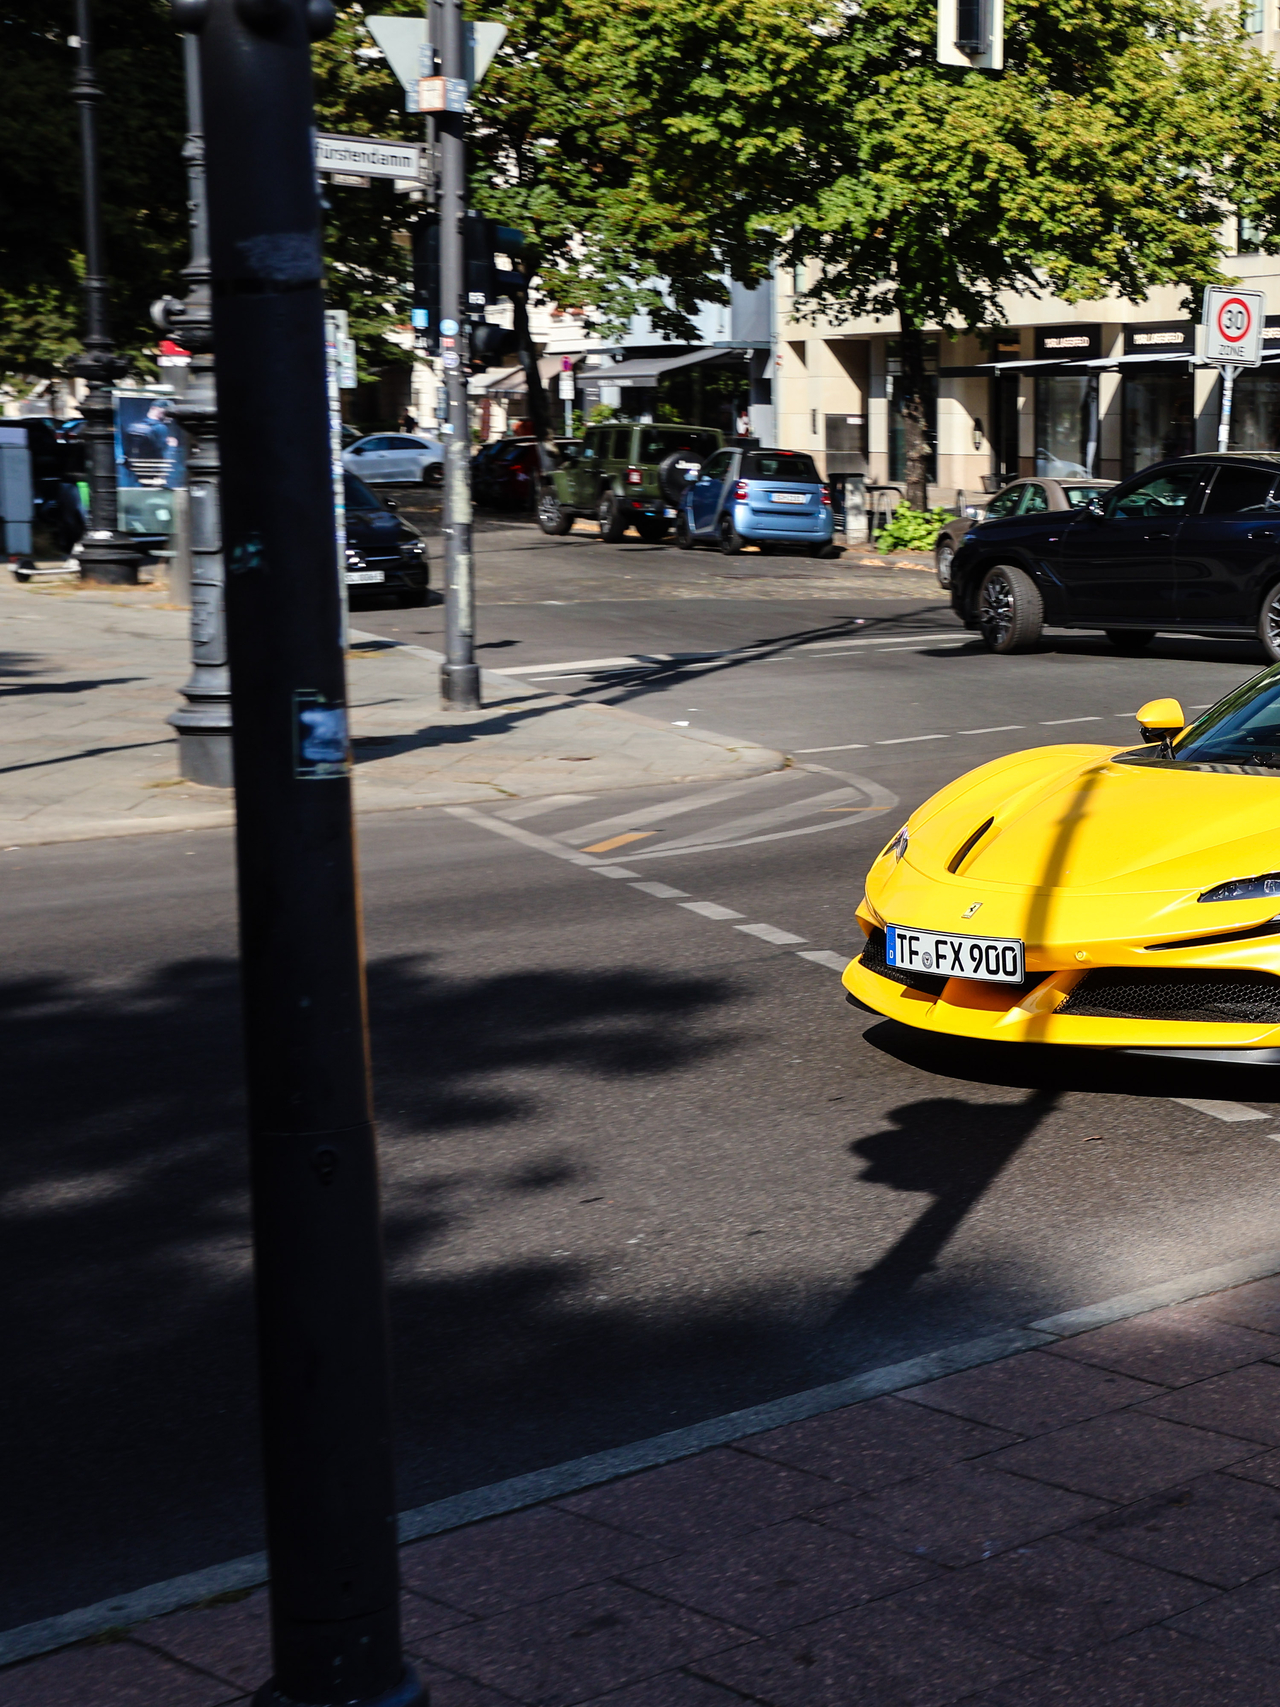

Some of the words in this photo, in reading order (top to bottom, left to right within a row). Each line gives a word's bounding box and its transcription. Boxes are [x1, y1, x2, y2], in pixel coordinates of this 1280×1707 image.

[315, 141, 412, 168] fürstendamm
[1223, 309, 1245, 331] 30
[1218, 344, 1246, 357] ZONE
[897, 933, 920, 965] TF
[935, 939, 965, 972] FX
[969, 943, 1018, 977] 900
